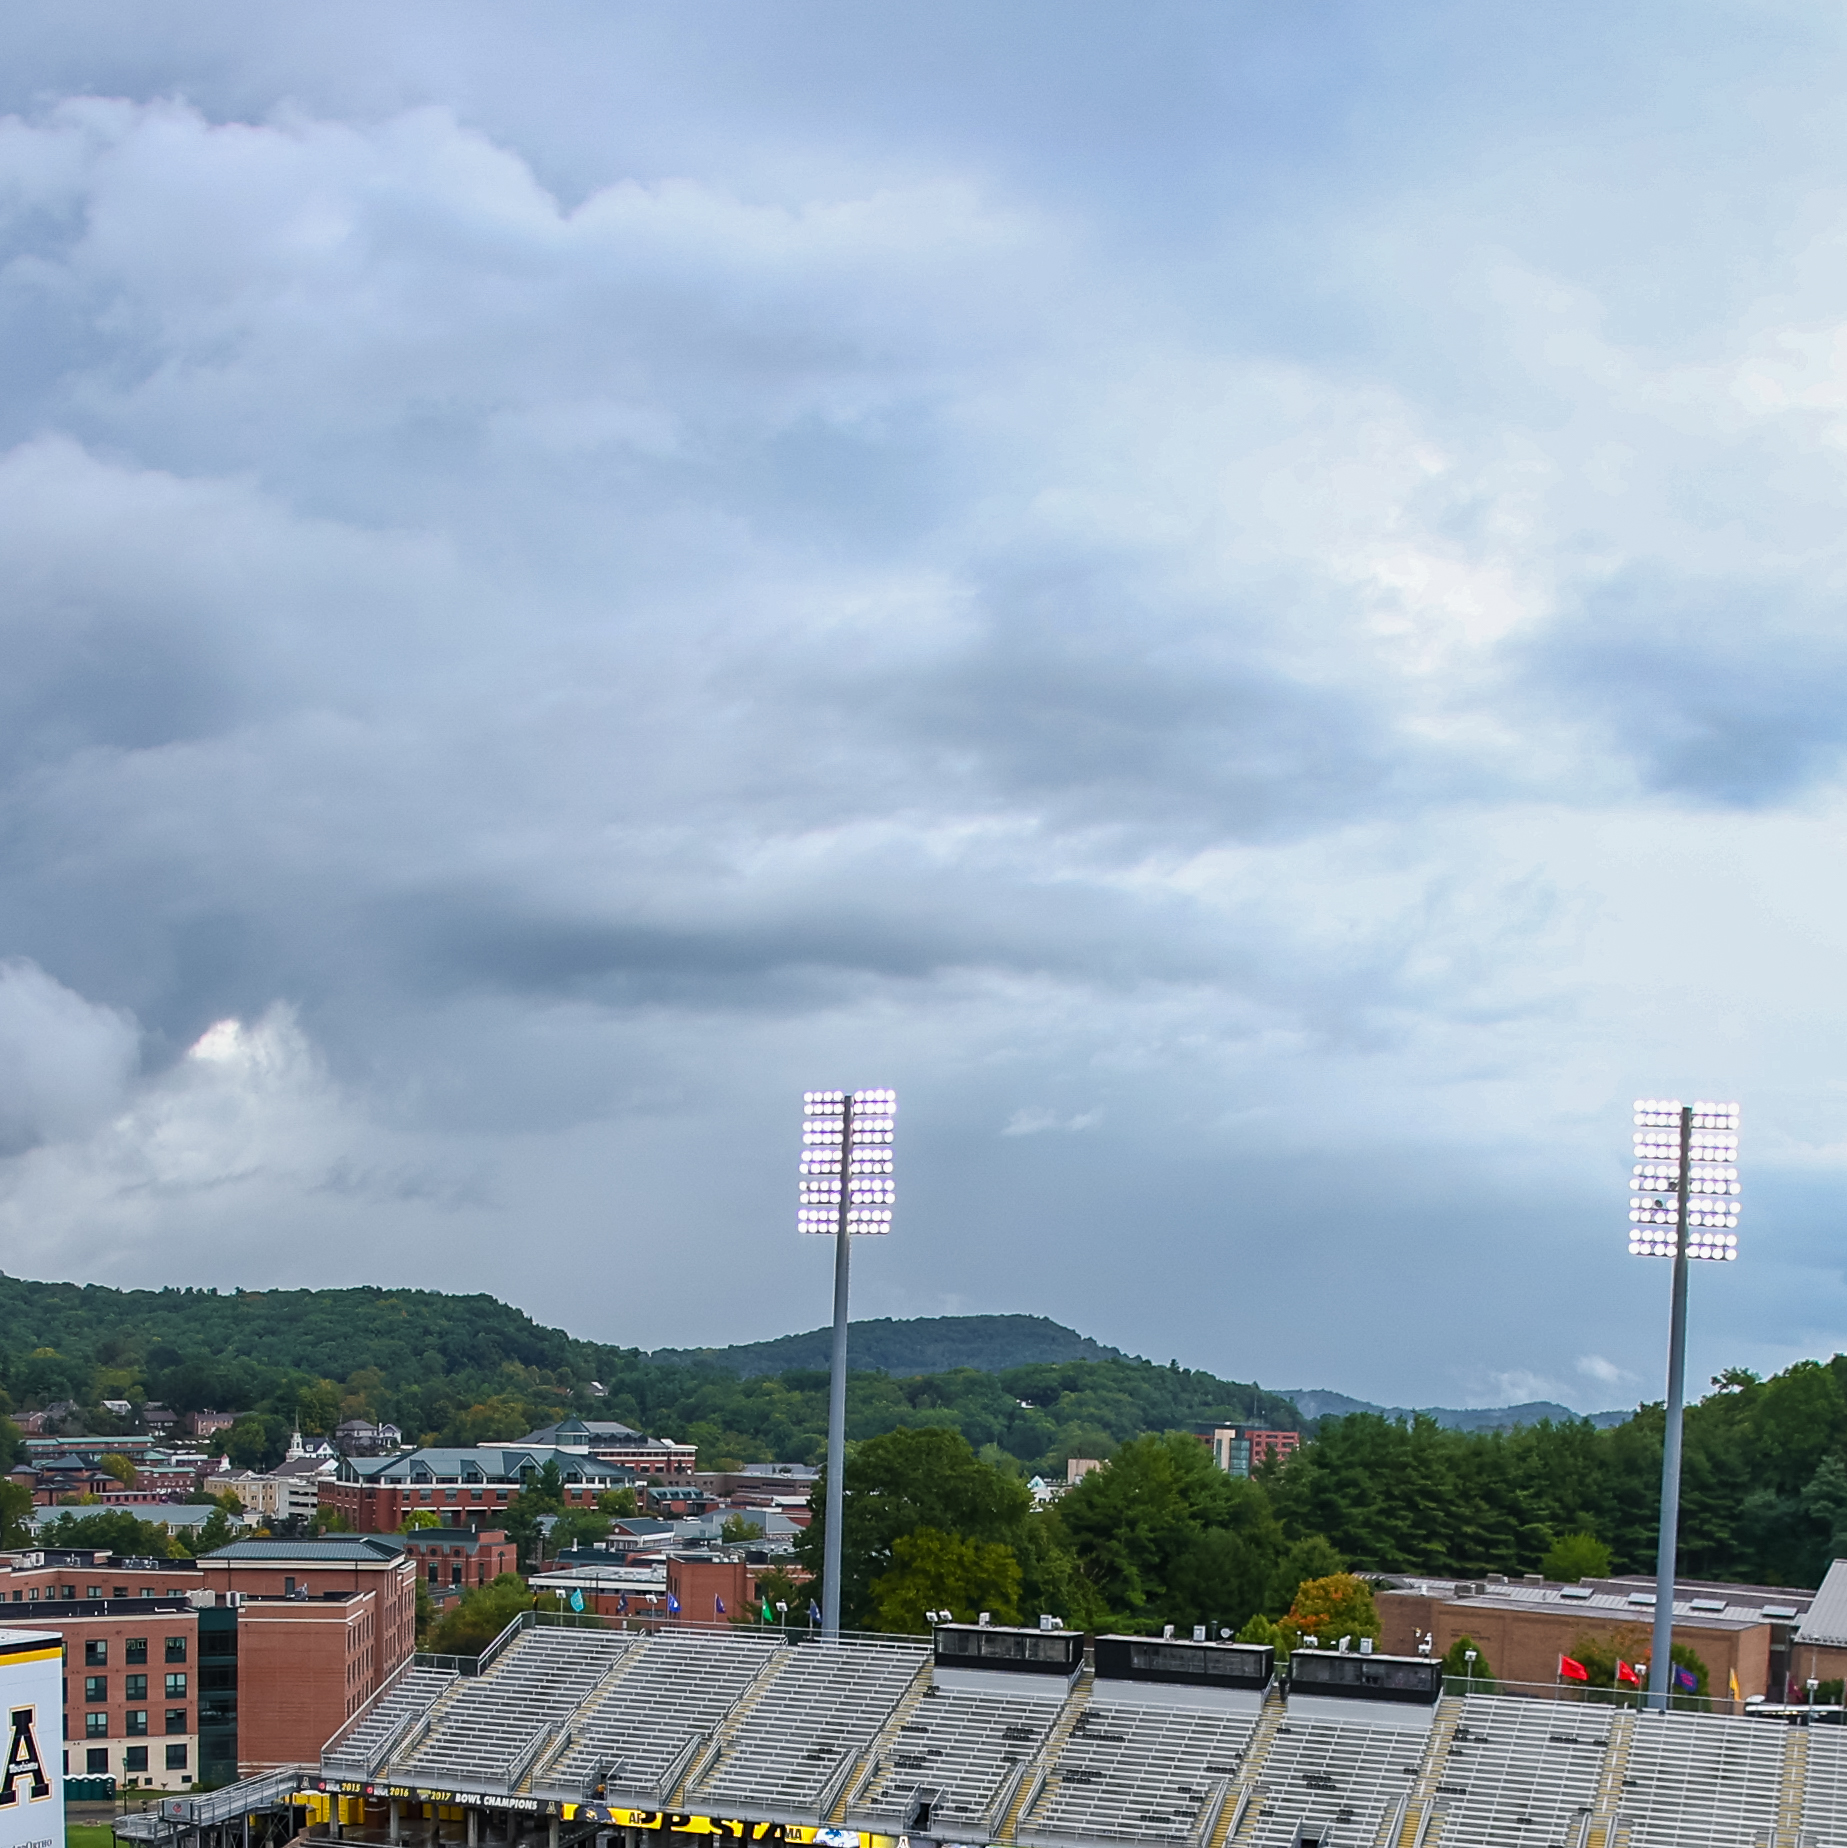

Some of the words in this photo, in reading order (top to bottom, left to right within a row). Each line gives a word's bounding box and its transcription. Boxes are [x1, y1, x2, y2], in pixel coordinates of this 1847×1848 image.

[342, 1782, 361, 1793] 2015
[389, 1786, 410, 1797] 2016
[430, 1790, 452, 1801] 2017
[455, 1793, 481, 1805] BOWL
[484, 1796, 538, 1811] CHAMPIONS
